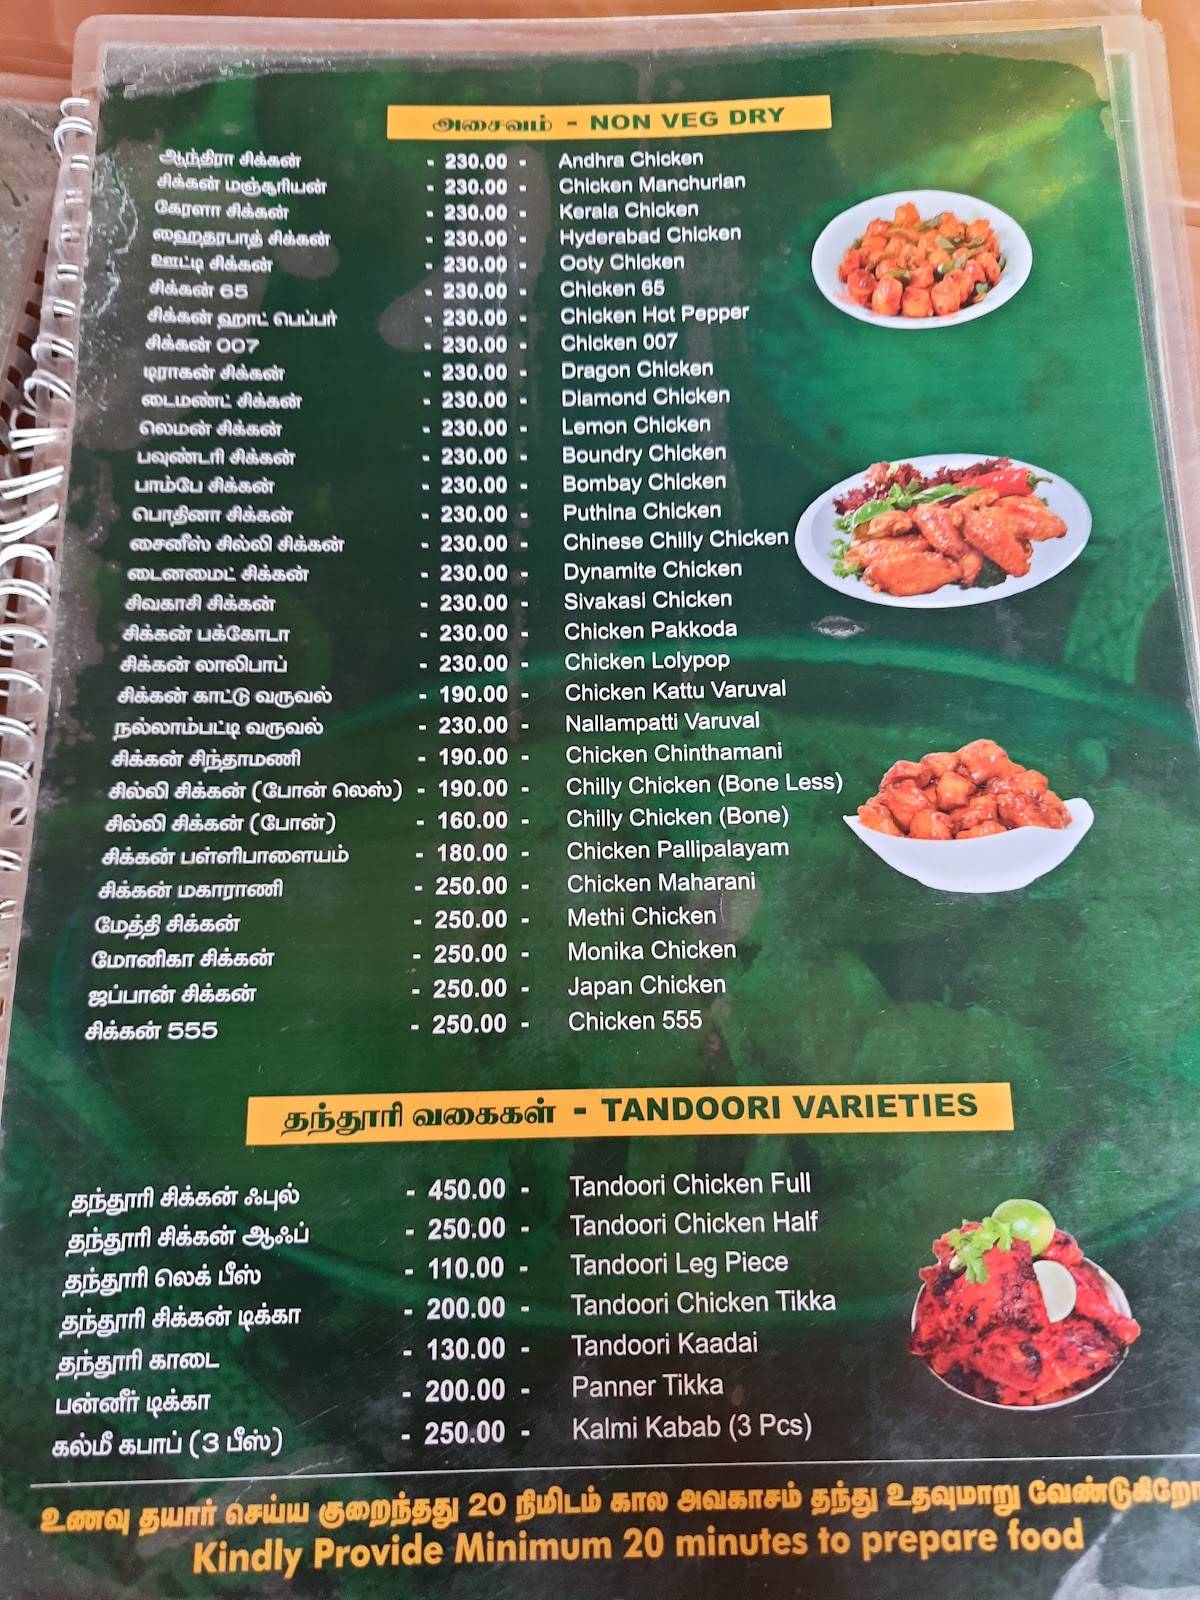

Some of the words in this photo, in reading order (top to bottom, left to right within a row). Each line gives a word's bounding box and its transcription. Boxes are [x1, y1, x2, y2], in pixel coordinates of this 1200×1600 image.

[432, 114, 553, 132] அசைவம்
[591, 115, 650, 130] NON
[662, 112, 718, 128] VEG
[730, 108, 784, 125] DRY
[559, 152, 624, 169] Andhra
[630, 150, 703, 168] Chicken
[445, 178, 507, 195] 230.00
[559, 177, 633, 194] Chicken
[639, 174, 745, 193] Manchurian
[560, 202, 618, 220] Kerala
[625, 201, 698, 219] Chicken
[560, 227, 660, 249] Hyderabad
[667, 225, 741, 243] Chicken
[560, 254, 604, 275] Ooty
[610, 253, 684, 270] Chicken
[560, 280, 635, 298] Chicken
[641, 278, 665, 296] 65
[443, 307, 507, 328] 230.00
[561, 306, 636, 325] Chicken
[643, 305, 676, 324] Hot
[682, 304, 749, 325] Pepper
[561, 333, 637, 352] Chicken
[643, 332, 678, 350] 007
[562, 361, 630, 382] Dragon
[637, 360, 713, 378] Chicken
[562, 387, 646, 407] Diamond
[653, 386, 730, 405] Chicken
[442, 416, 507, 437] 230.00
[562, 417, 627, 435] Lemon
[634, 415, 711, 434] Chicken
[563, 445, 643, 466] Boundry
[649, 443, 726, 462] Chicken
[135, 475, 203, 493] பாம்பே
[207, 476, 275, 494] சிக்கன்
[563, 474, 642, 495] Bombay
[648, 472, 726, 491] Chicken
[564, 503, 636, 521] Puthina
[643, 501, 721, 520] Chicken
[440, 534, 507, 552] 230.00
[564, 533, 643, 551] Chinese
[650, 529, 704, 553] Chilly
[709, 528, 790, 549] Chicken
[564, 561, 656, 584] Dynamite
[663, 560, 742, 578] Chicken
[564, 591, 646, 610] Sivakasi
[653, 590, 732, 608] Chicken
[565, 622, 644, 640] Chicken
[651, 619, 737, 638] Pakkoda
[565, 652, 645, 671] Chicken
[652, 651, 732, 673] Lolypop
[440, 685, 508, 703] 190.00
[565, 683, 645, 701] Chicken
[653, 677, 704, 700] Kattu
[710, 679, 788, 698] Varuval
[566, 713, 678, 735] Nallampatti
[684, 711, 759, 730] Varuval
[566, 745, 647, 765] Chicken
[654, 742, 782, 762] Chinthamani
[566, 777, 622, 799] Chilly
[629, 776, 710, 794] Chicken
[718, 775, 779, 797] (Bone
[786, 772, 843, 794] Less)
[567, 809, 623, 831] Chilly
[629, 808, 712, 826] Chicken
[719, 805, 789, 829] (Bone)
[438, 843, 507, 862] 180.00
[567, 841, 650, 860] Chicken
[658, 839, 789, 862] Pallipalayam
[568, 874, 651, 892] Chicken
[659, 873, 755, 891] Maharani
[568, 907, 624, 926] Methi
[632, 905, 717, 925] Chicken
[569, 941, 644, 961] Monika
[651, 940, 736, 959] Chicken
[432, 978, 507, 998] 250.00
[568, 977, 632, 1000] Japan
[640, 974, 726, 994] Chicken
[85, 1020, 162, 1040] சிக்கன்
[167, 1021, 218, 1040] 555
[569, 1011, 655, 1031] Chicken
[663, 1010, 702, 1029] 555
[282, 1101, 402, 1135] தந்தூரி
[413, 1098, 556, 1126] வகைகள்
[601, 1096, 780, 1121] TANDOORI
[793, 1094, 977, 1118] VARIETIES
[428, 1178, 505, 1200] 450.00
[570, 1174, 665, 1197] Tandoori
[673, 1173, 763, 1195] Chicken
[771, 1172, 810, 1193] Full
[69, 1186, 154, 1217] தந்தூரி
[160, 1185, 239, 1207] சிக்கன்
[244, 1182, 300, 1211] ஃபுல்
[428, 1216, 505, 1240] 250.00
[570, 1213, 666, 1237] Tandoori
[675, 1212, 765, 1234] Chicken
[773, 1210, 818, 1232] Half
[65, 1225, 151, 1258] தந்தூரி
[157, 1224, 236, 1247] சிக்கன்
[242, 1221, 309, 1250] ஆஃப்
[429, 1256, 504, 1279] 110.00
[570, 1252, 667, 1276] Tandoori
[676, 1252, 717, 1278] Leg
[726, 1251, 788, 1272] Piece
[62, 1265, 148, 1298] தந்தூரி
[155, 1263, 212, 1288] லெக்
[218, 1261, 261, 1286] பீஸ்
[427, 1296, 505, 1320] 200.00
[571, 1292, 668, 1316] Tandoori
[677, 1291, 768, 1314] Chicken
[775, 1289, 836, 1311] Tikka
[59, 1306, 145, 1339] தந்தூரி
[152, 1304, 232, 1328] சிக்கன்
[238, 1304, 301, 1332] டிக்கா
[427, 1336, 505, 1360] 130.00
[571, 1333, 670, 1356] Tandoori
[679, 1331, 757, 1354] Kaadai
[55, 1348, 142, 1380] தந்தூரி
[149, 1352, 220, 1370] காடை
[425, 1378, 505, 1402] 200.00
[573, 1376, 656, 1398] Panner
[662, 1373, 723, 1395] Tikka
[56, 1388, 140, 1414] பன்னீர்
[146, 1388, 211, 1419] டிக்கா
[425, 1420, 505, 1445] 250.00
[573, 1416, 637, 1440] Kalmi
[646, 1415, 721, 1438] Kabab
[729, 1414, 751, 1442] (3
[760, 1413, 811, 1441] Pcs)
[52, 1430, 113, 1457] கல்மீ
[119, 1430, 182, 1455] கபாப்
[189, 1429, 219, 1459] (3
[41, 1508, 130, 1535] உணவு
[139, 1500, 216, 1536] தயார்
[226, 1495, 309, 1525] செய்ய
[319, 1491, 458, 1529] குறைந்தது
[469, 1493, 506, 1516] 20
[516, 1487, 601, 1522] நிமிடம்
[611, 1492, 668, 1512] கால
[677, 1481, 802, 1512] அவகாசம்
[811, 1482, 878, 1519] தந்து
[887, 1483, 1020, 1517] உதவுமாறு
[194, 1539, 302, 1579] Kindly
[315, 1533, 443, 1568] Provide
[455, 1531, 611, 1562] Minimum
[624, 1528, 663, 1557] 20
[677, 1526, 807, 1556] minutes
[818, 1527, 850, 1554] to
[862, 1530, 997, 1561] prepare
[1008, 1519, 1083, 1551] food
